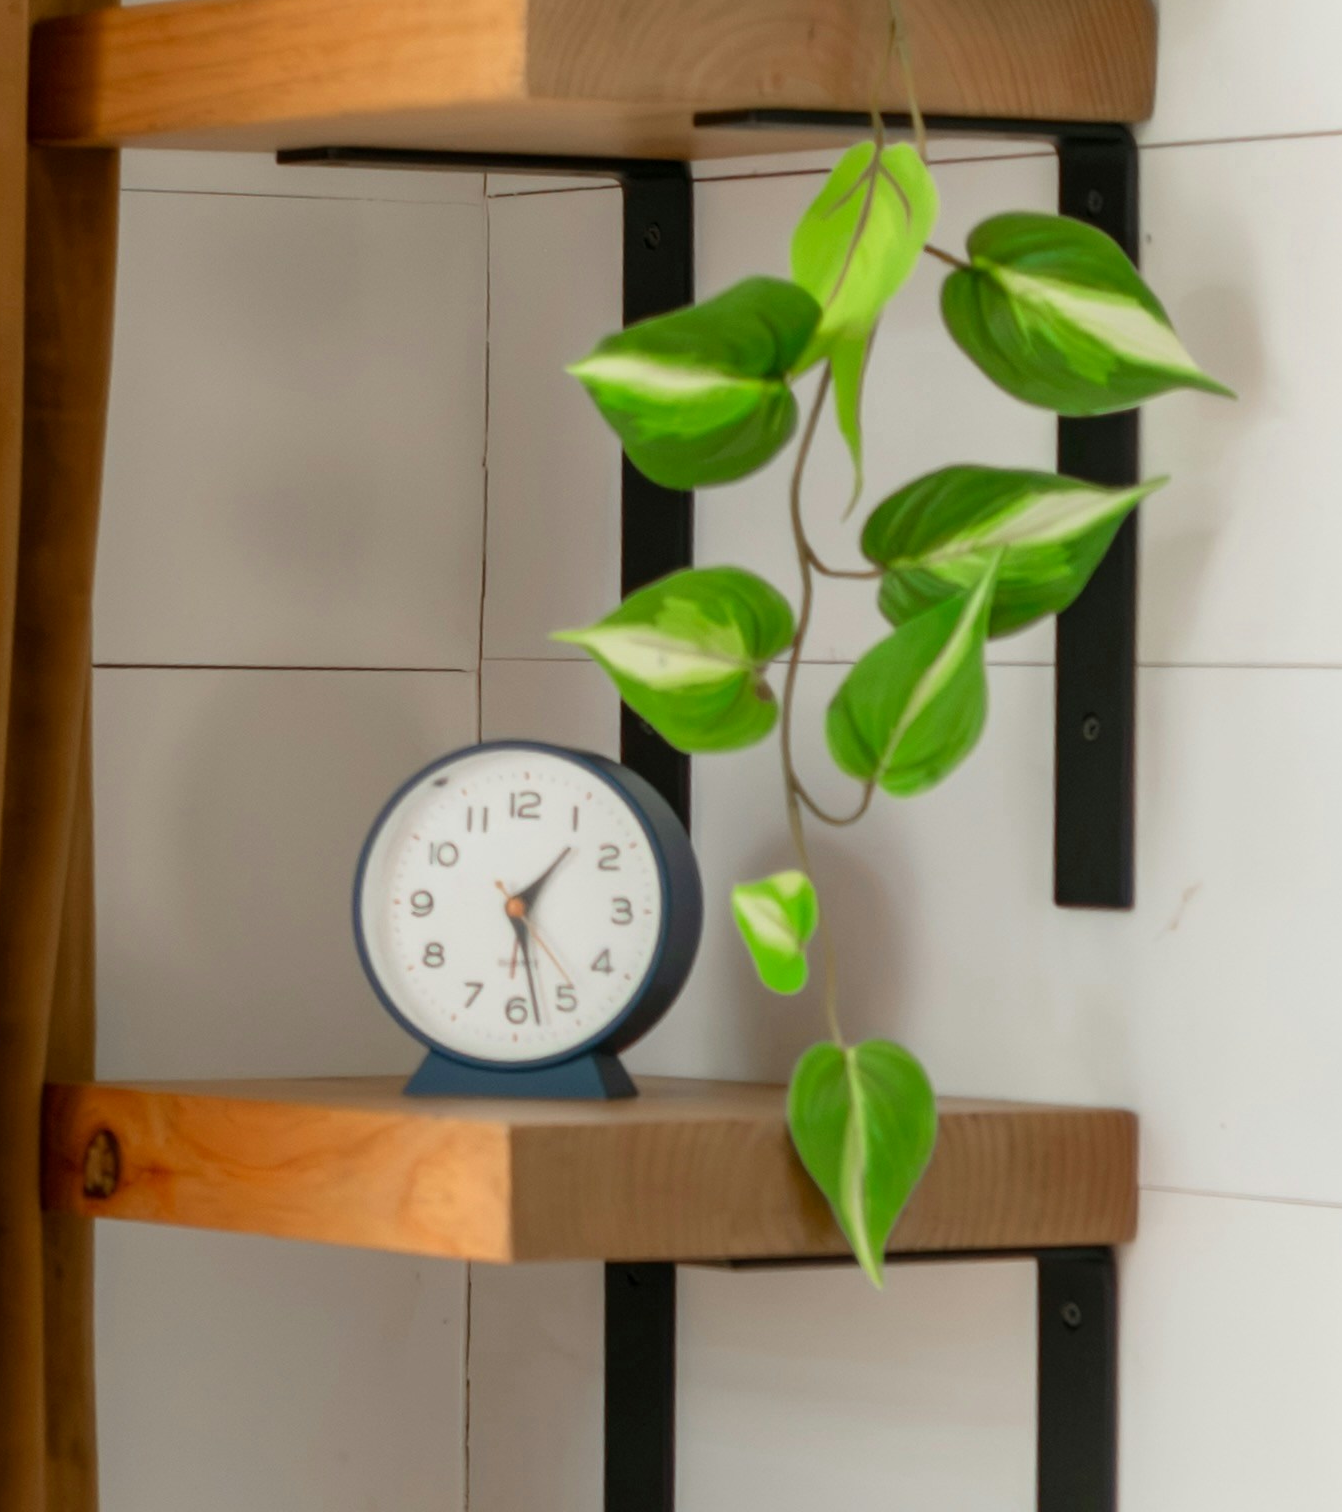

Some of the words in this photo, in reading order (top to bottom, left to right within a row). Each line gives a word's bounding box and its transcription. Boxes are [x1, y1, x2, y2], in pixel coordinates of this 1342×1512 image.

[509, 791, 542, 819] 12
[571, 804, 579, 832] 1
[466, 806, 489, 833] 11
[429, 841, 459, 867] 10
[597, 844, 622, 871] 2
[410, 890, 434, 917] 9
[611, 897, 634, 925] 3
[422, 942, 445, 968] 8
[590, 948, 614, 974] 4
[464, 982, 484, 1008] 7
[556, 985, 578, 1012] 5
[505, 996, 528, 1025] 6
